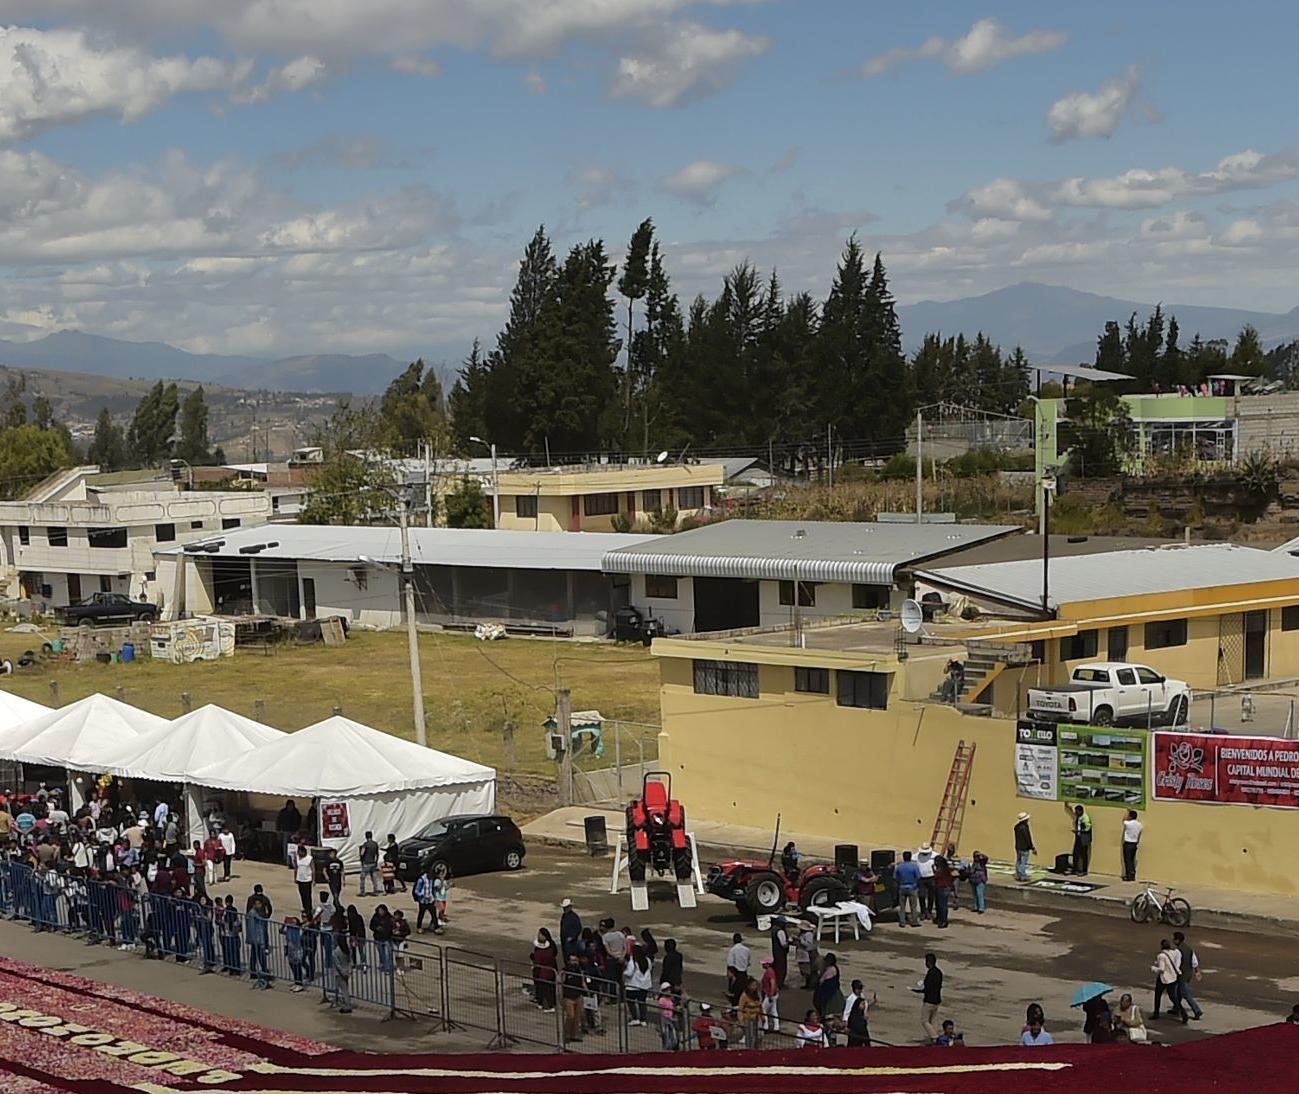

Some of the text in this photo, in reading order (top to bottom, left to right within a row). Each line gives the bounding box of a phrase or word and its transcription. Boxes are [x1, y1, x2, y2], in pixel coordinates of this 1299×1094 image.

[1037, 700, 1063, 709] TOYOTA
[1221, 748, 1268, 761] BIENVENIDOS
[1268, 750, 1275, 761] A
[1275, 751, 1299, 762] PEDRO
[1227, 764, 1255, 776] CAPITAL
[1256, 766, 1290, 778] MUNDIAL
